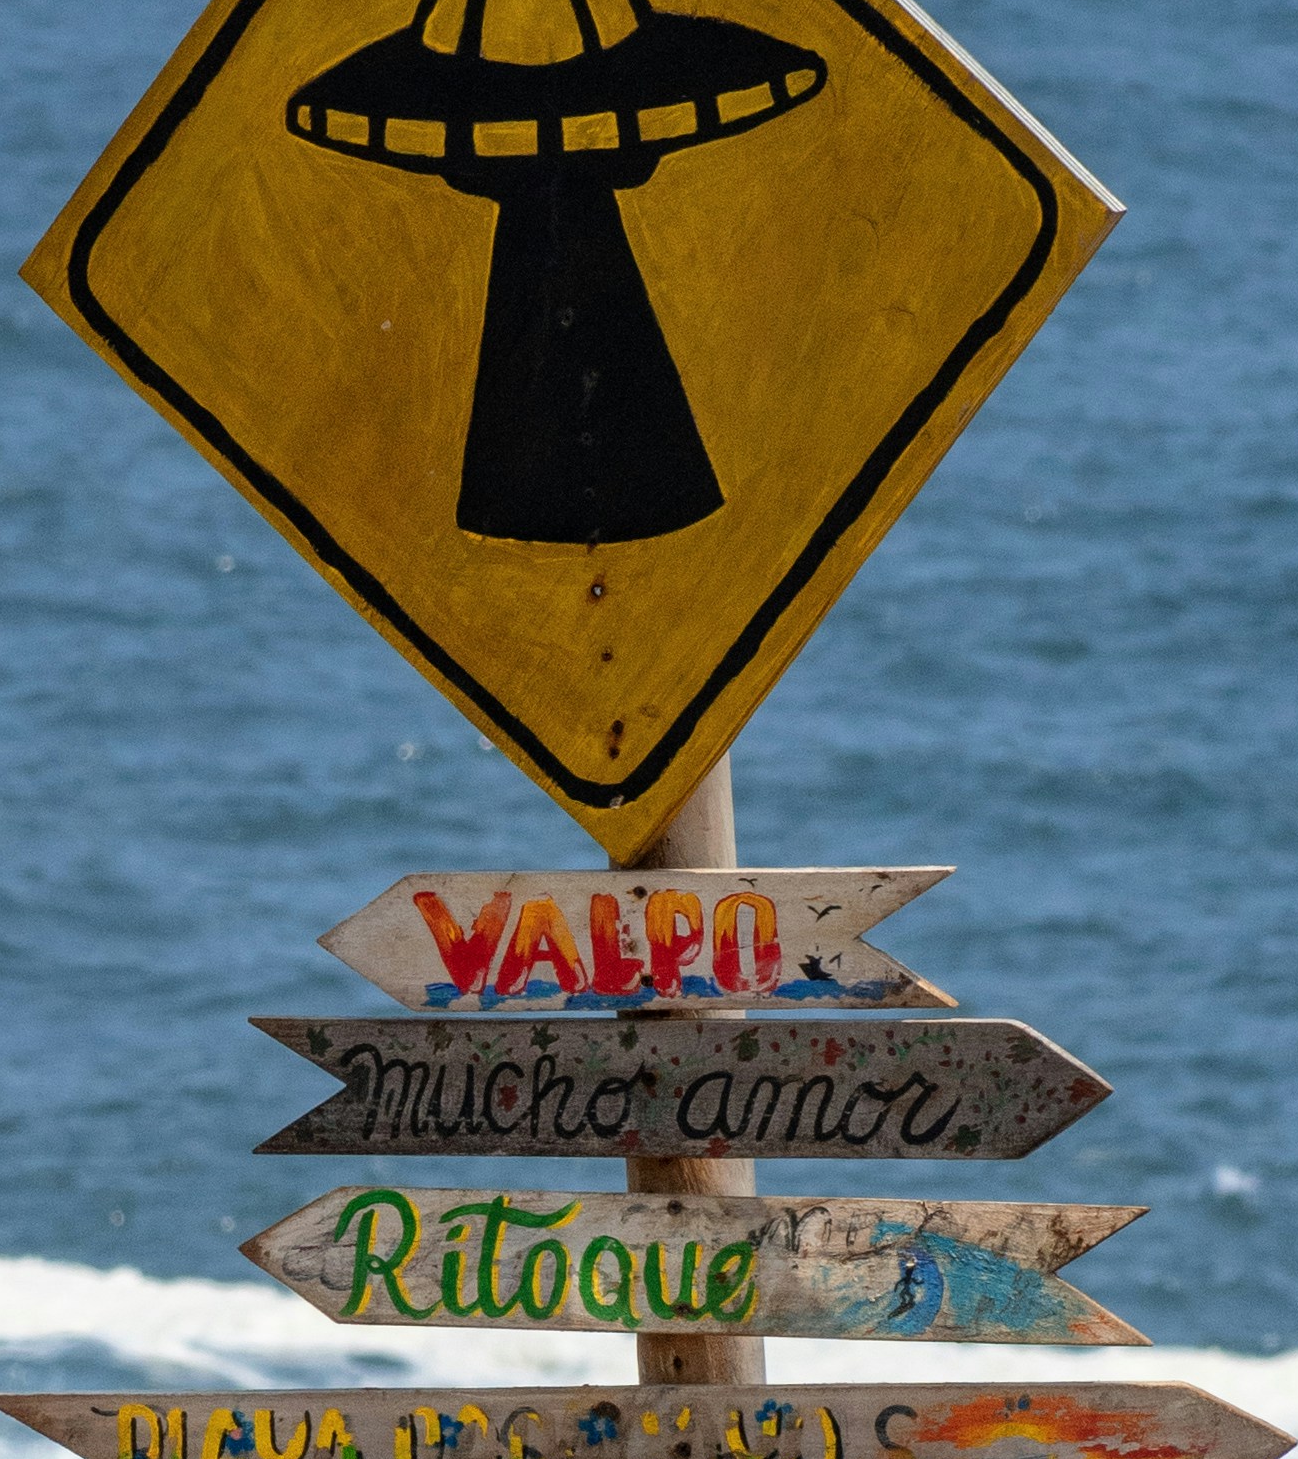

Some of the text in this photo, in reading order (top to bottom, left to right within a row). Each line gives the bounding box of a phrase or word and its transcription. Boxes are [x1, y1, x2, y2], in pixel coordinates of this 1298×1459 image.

[413, 889, 783, 998] VALPO
[340, 1042, 961, 1143] mucho amor
[333, 1188, 759, 1326] Ritoque
